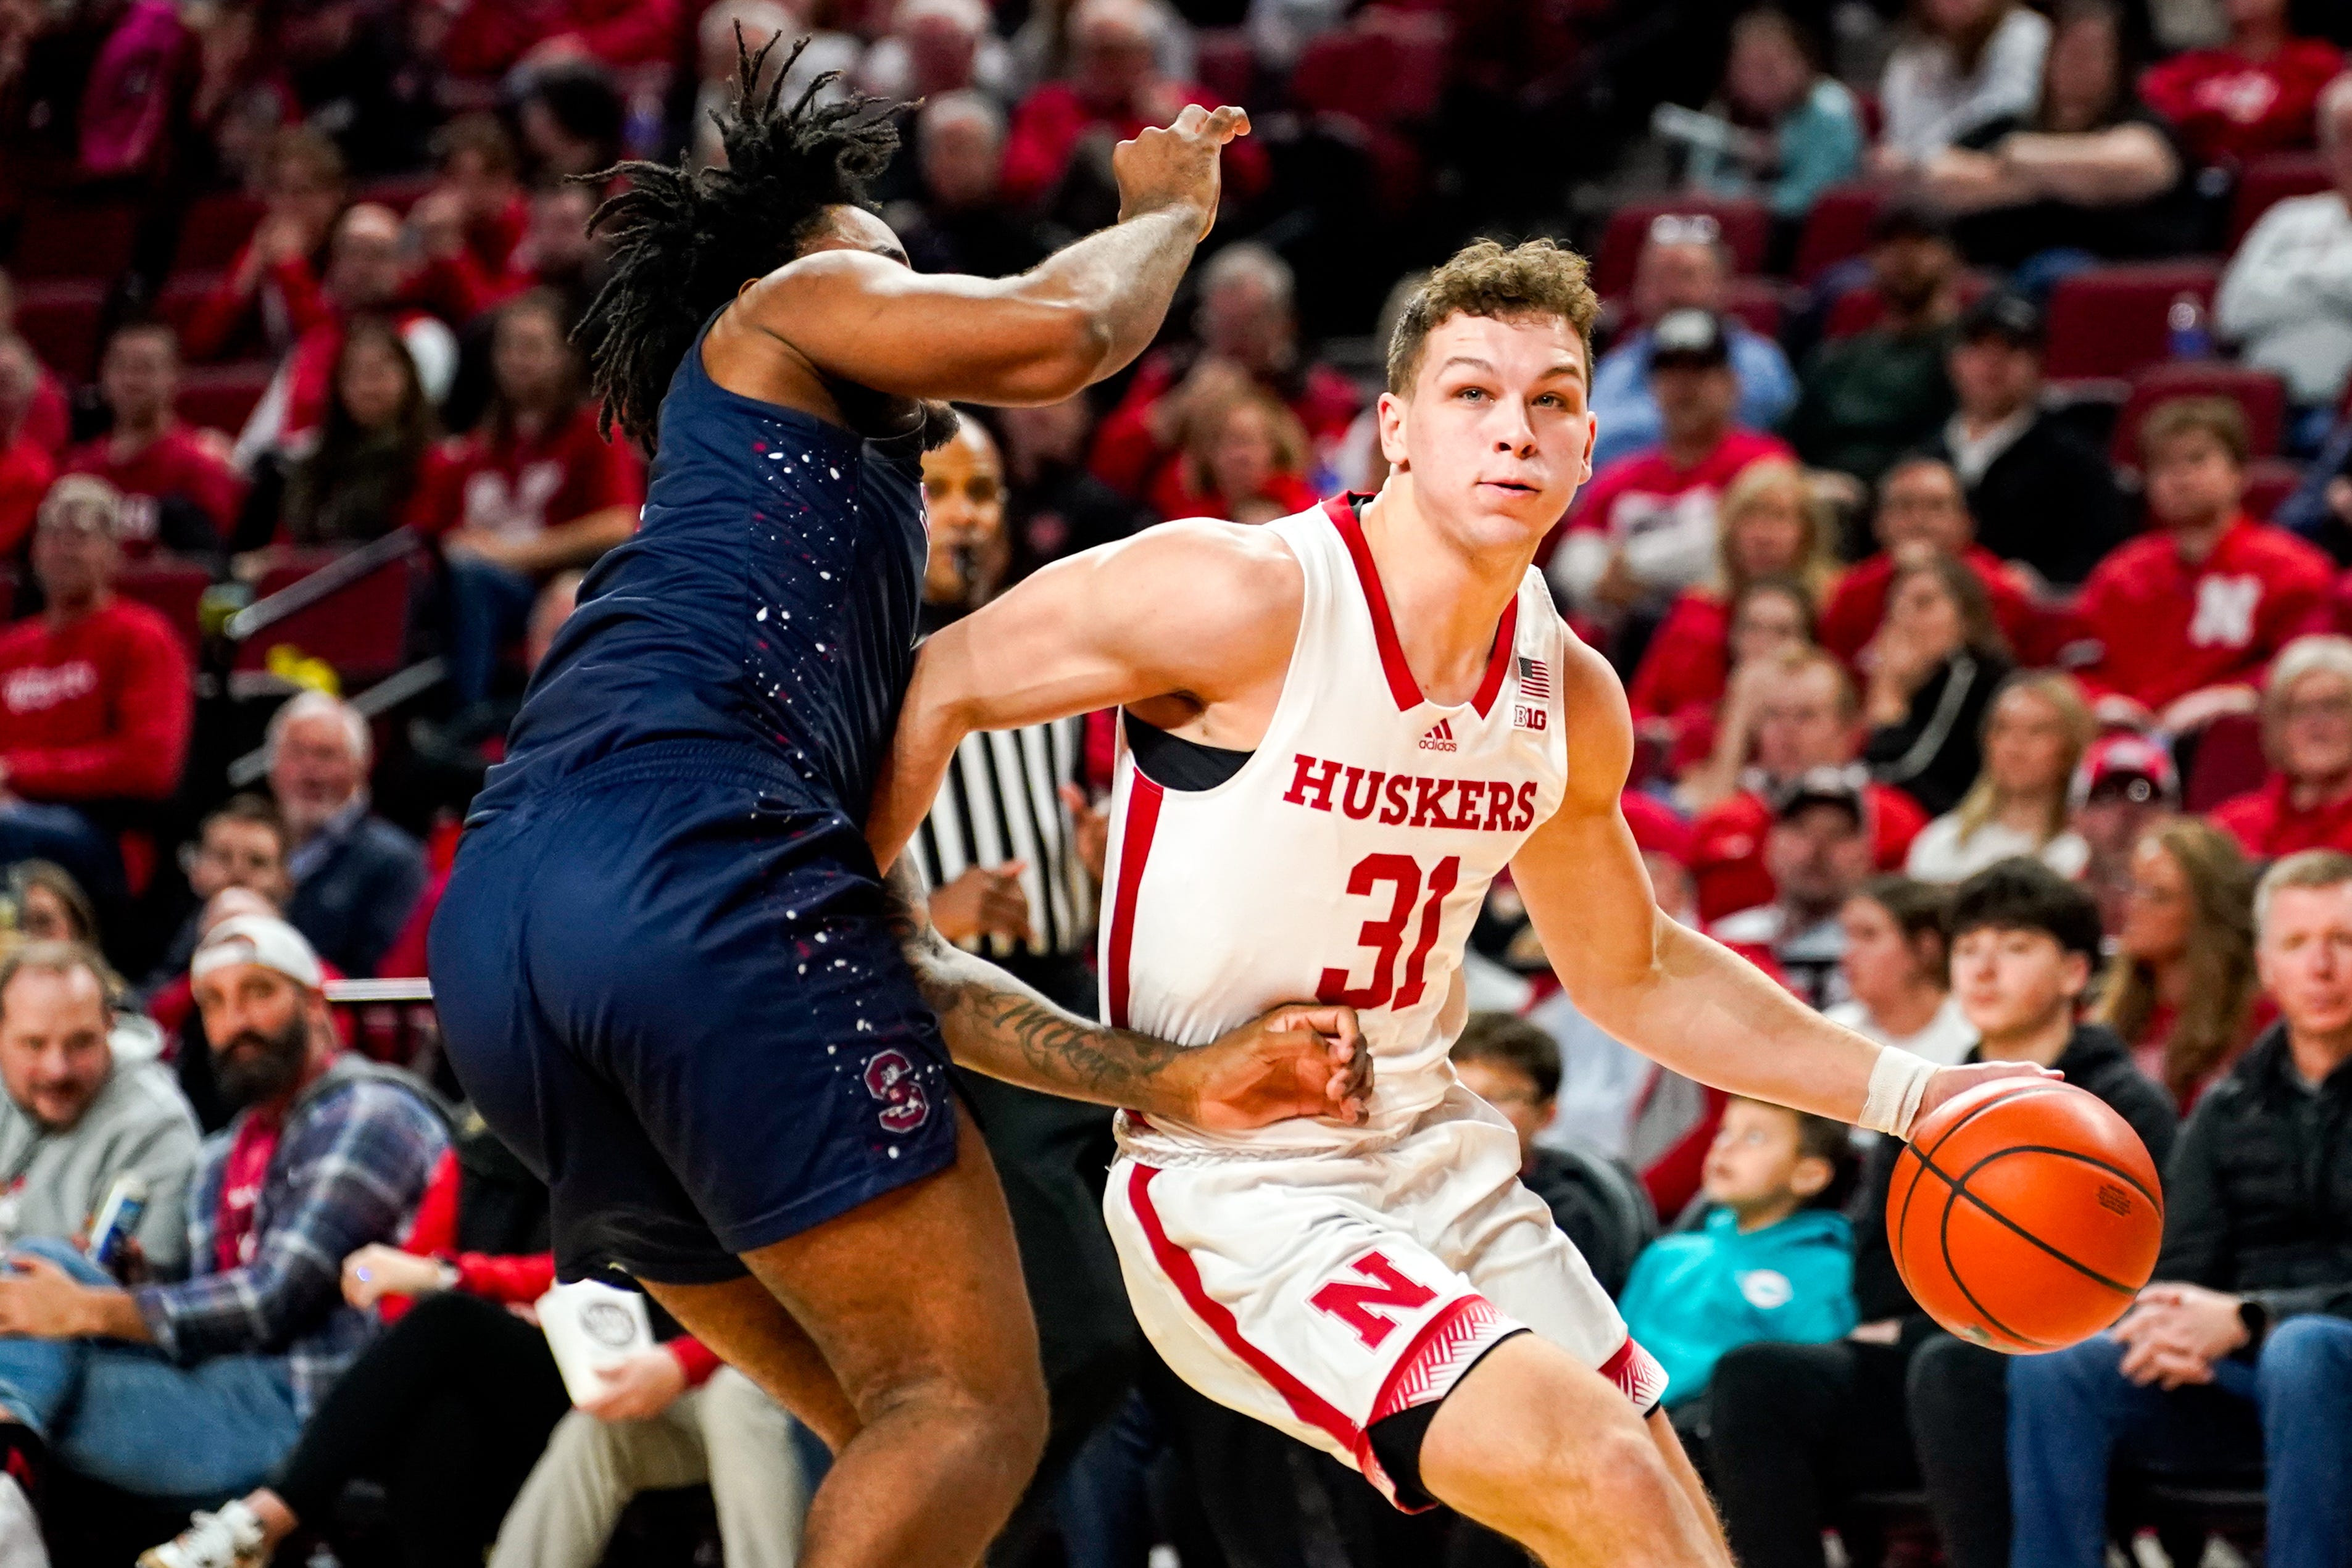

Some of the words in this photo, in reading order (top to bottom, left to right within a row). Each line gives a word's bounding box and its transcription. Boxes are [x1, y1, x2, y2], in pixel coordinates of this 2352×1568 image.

[1419, 739, 1457, 752] adidas
[1283, 753, 1537, 832] HUSKERS
[1315, 853, 1460, 1012] 31
[1308, 1250, 1439, 1353] N
